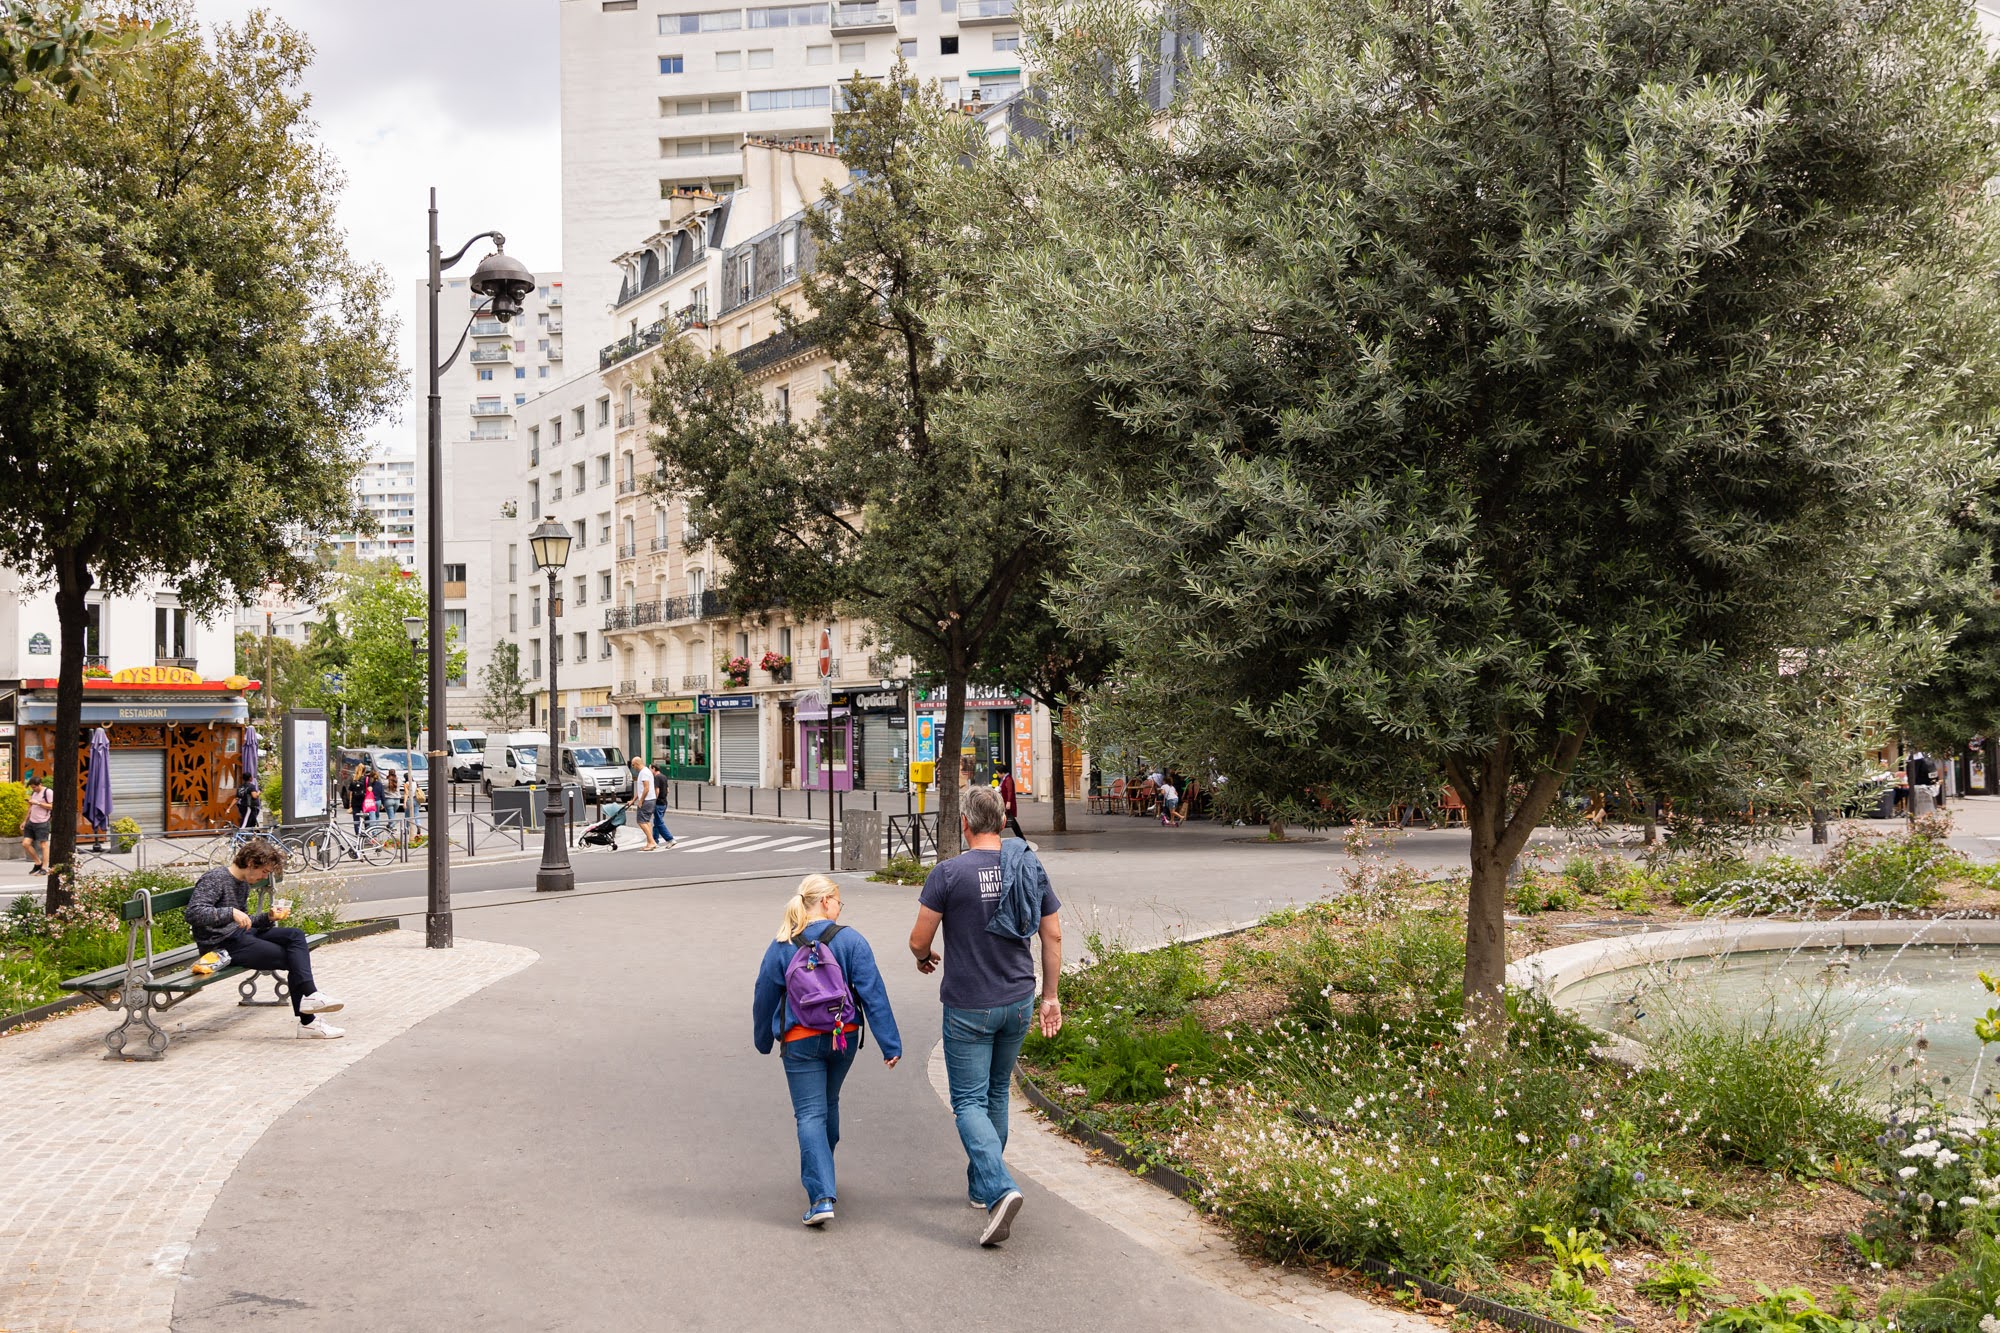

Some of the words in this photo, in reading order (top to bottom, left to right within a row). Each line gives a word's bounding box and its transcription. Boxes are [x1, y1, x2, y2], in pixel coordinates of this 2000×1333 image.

[121, 667, 151, 683] LYS
[931, 683, 1007, 701] PHMACIE
[856, 693, 898, 710] Opticlair
[119, 708, 168, 718] RESTAURANT
